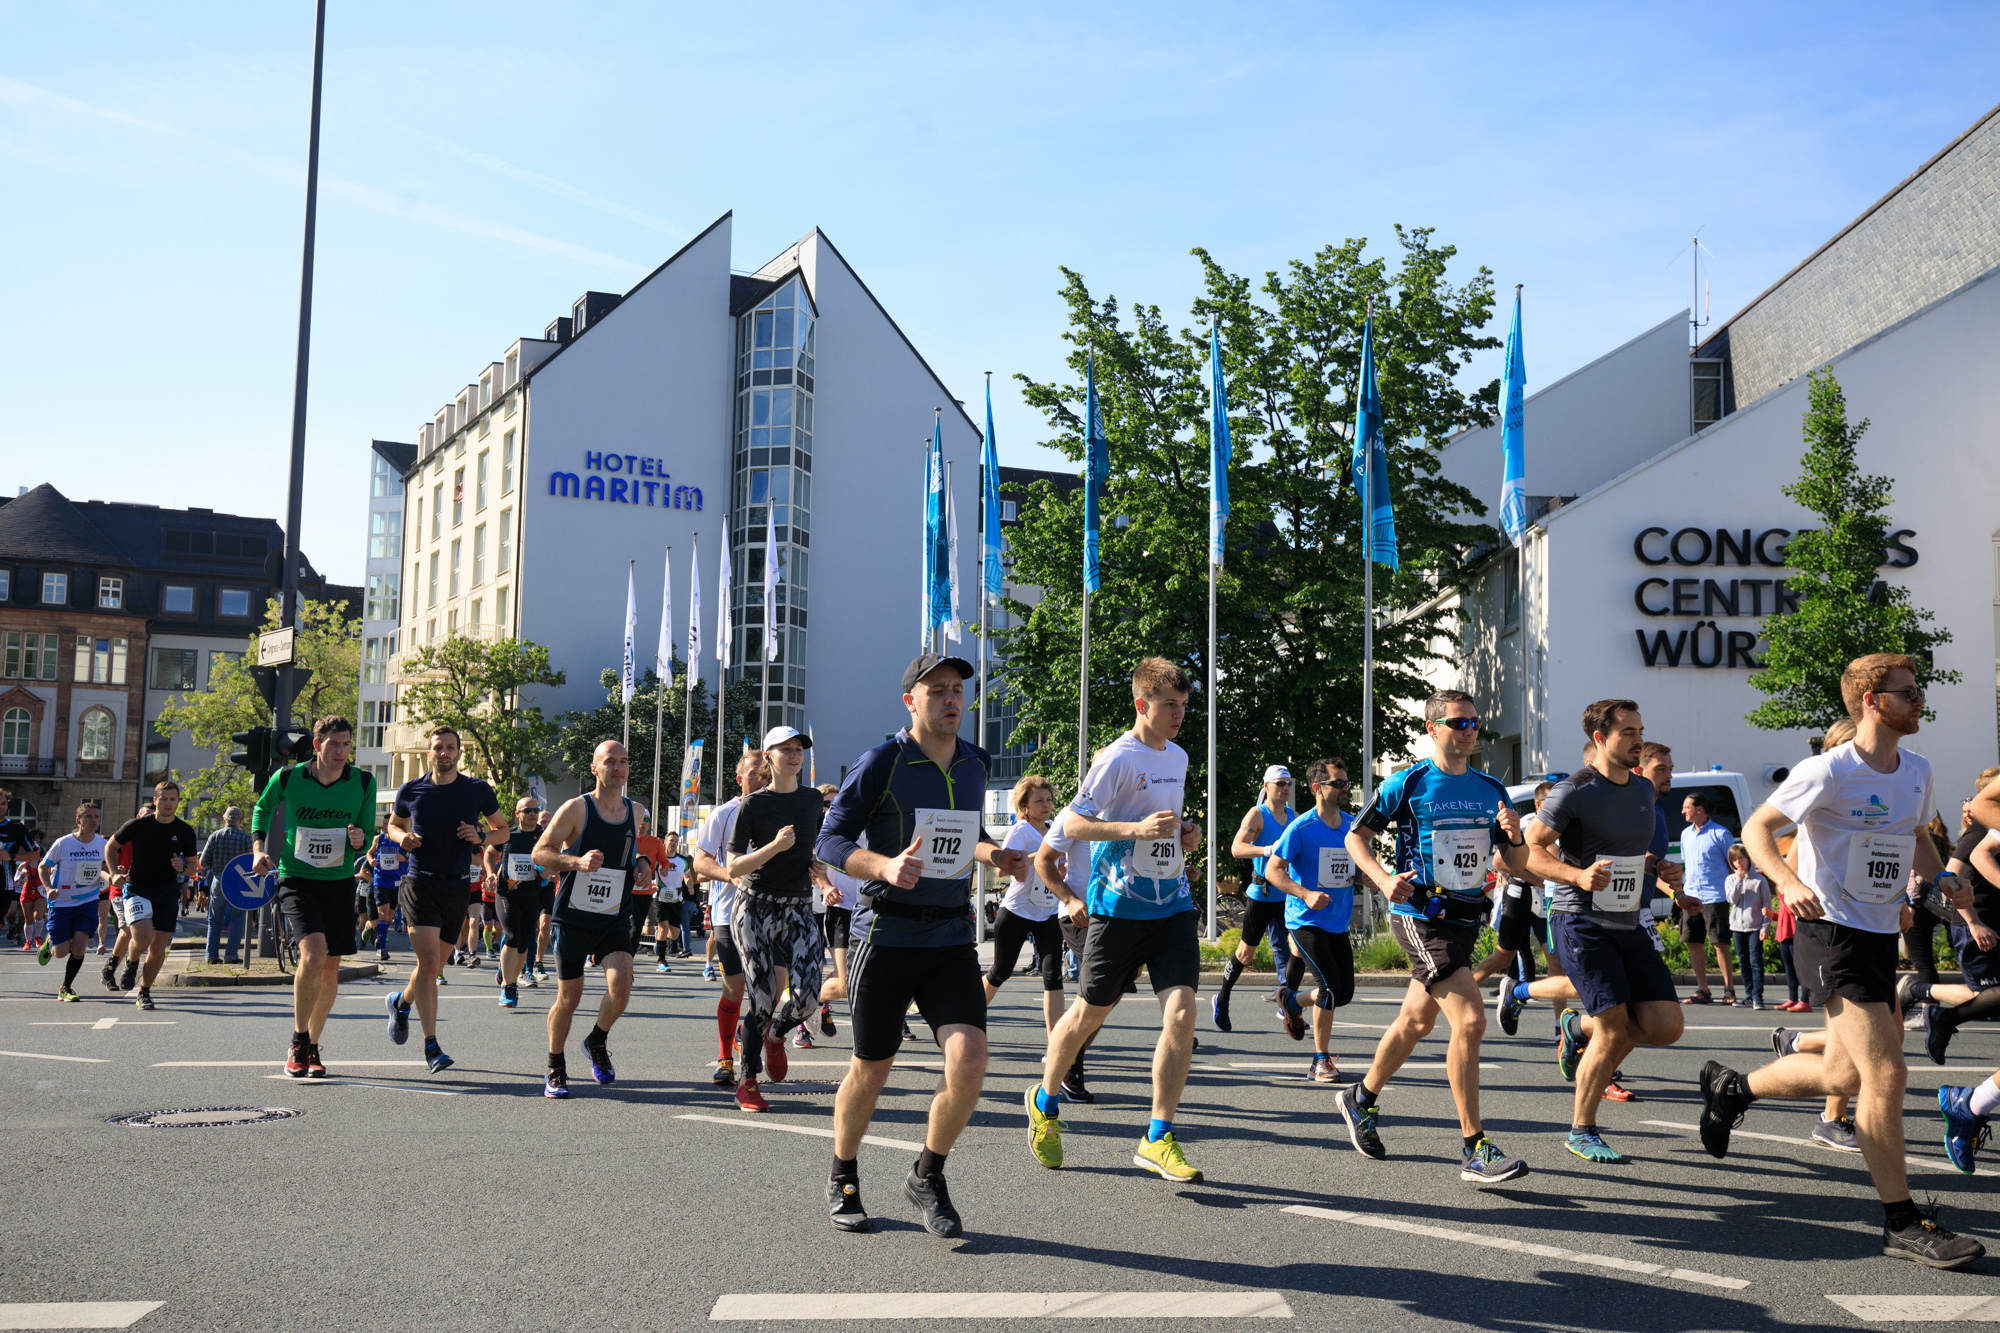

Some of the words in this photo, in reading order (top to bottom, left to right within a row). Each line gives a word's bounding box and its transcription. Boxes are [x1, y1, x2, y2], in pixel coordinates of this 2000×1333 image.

[586, 450, 670, 478] HOTEL
[550, 471, 703, 511] MARITIM
[1634, 527, 1919, 568] CONGSS
[295, 806, 352, 820] Metten
[308, 843, 332, 854] 2116
[932, 836, 962, 855] 1712
[1150, 842, 1175, 858] 2161
[932, 856, 955, 865] Michael
[1453, 852, 1478, 868] 429
[1871, 850, 1899, 858] Halbmarathon
[1330, 863, 1349, 874] 1221
[1867, 860, 1900, 880] 1976
[587, 884, 611, 898] 1441
[1612, 878, 1635, 892] 1778
[1872, 880, 1893, 889] Jochen
